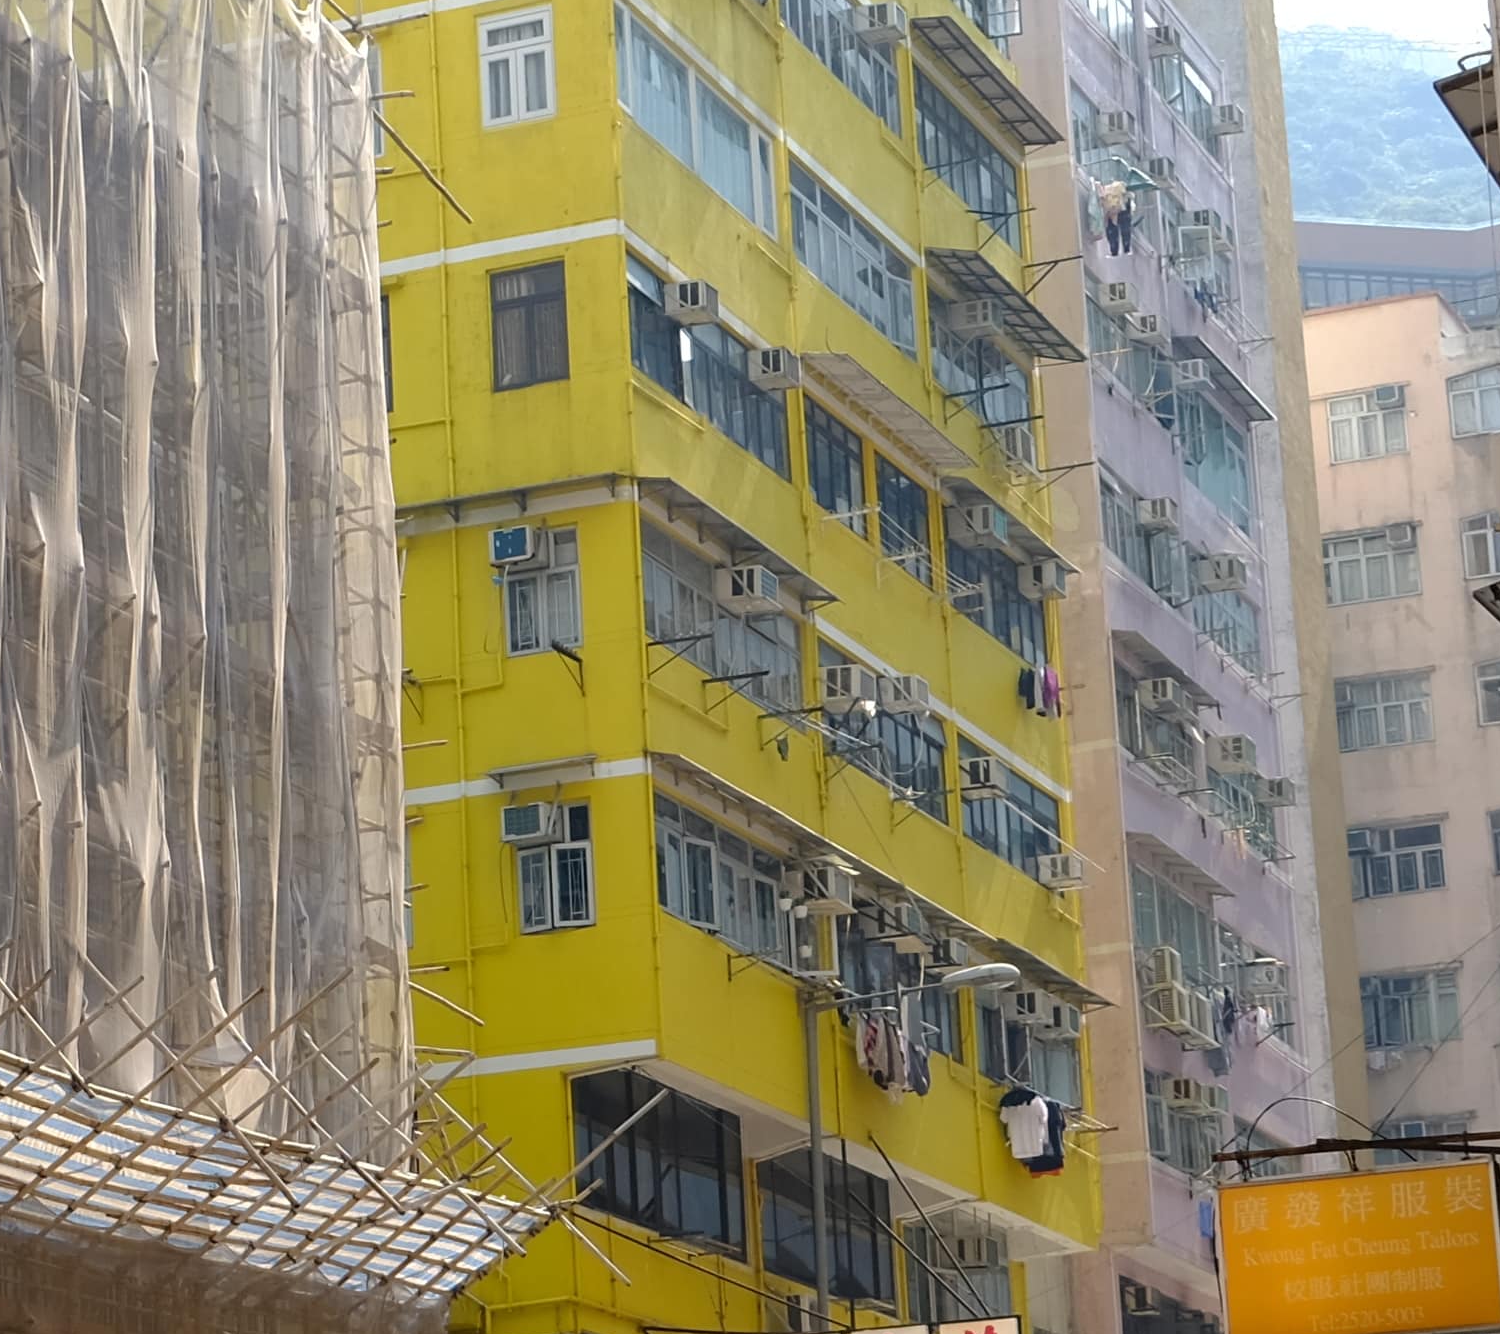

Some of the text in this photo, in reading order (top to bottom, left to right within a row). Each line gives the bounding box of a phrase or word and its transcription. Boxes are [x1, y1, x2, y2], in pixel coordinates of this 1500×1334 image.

[1233, 1175, 1485, 1235] 廣發祥服裝
[1243, 1229, 1480, 1268] Kwong Fat Cheung Tailors
